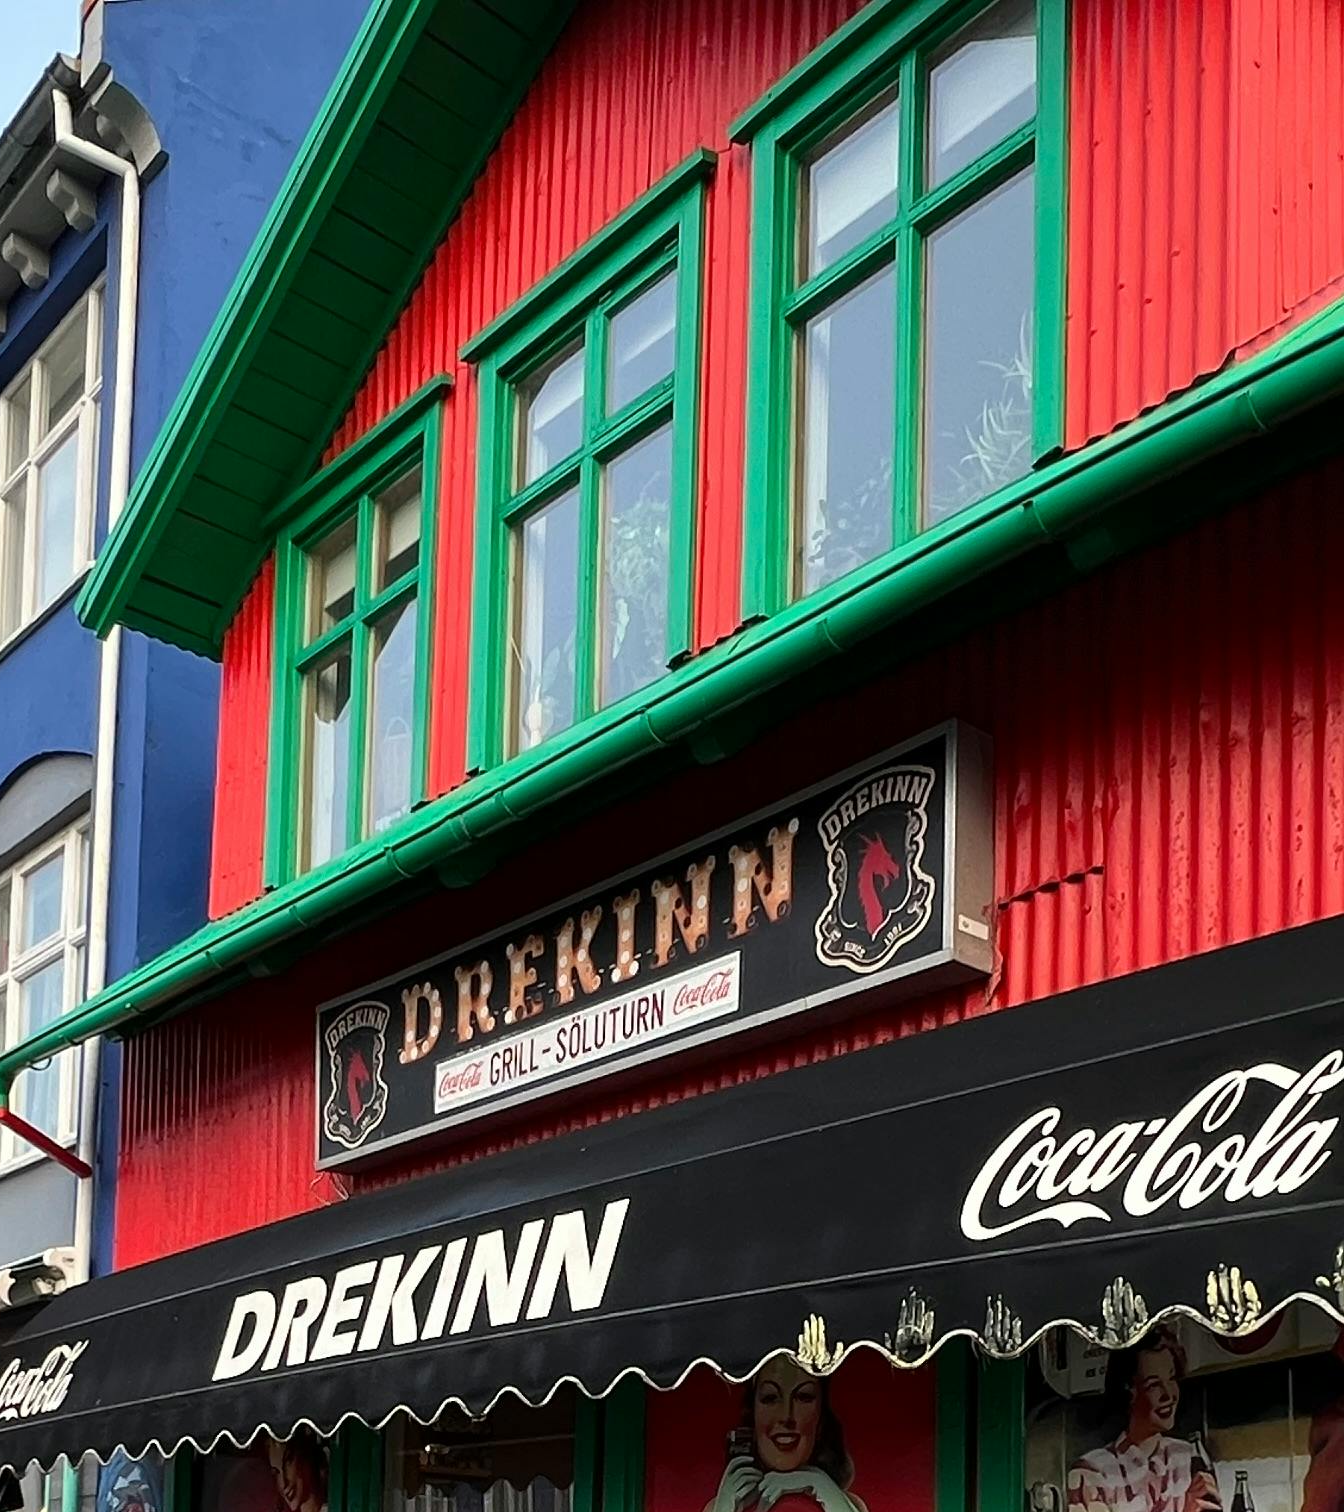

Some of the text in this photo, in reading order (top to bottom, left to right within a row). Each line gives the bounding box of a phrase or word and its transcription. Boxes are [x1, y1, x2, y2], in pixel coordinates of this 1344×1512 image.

[824, 774, 928, 841] DREKINN
[398, 817, 800, 1066] DREKINN
[329, 1006, 387, 1049] DREKINN
[490, 1038, 539, 1086] GRILL
[555, 988, 666, 1064] SÖLUTURN
[673, 967, 735, 1016] Coca-Cola
[211, 1198, 631, 1382] DREKINN
